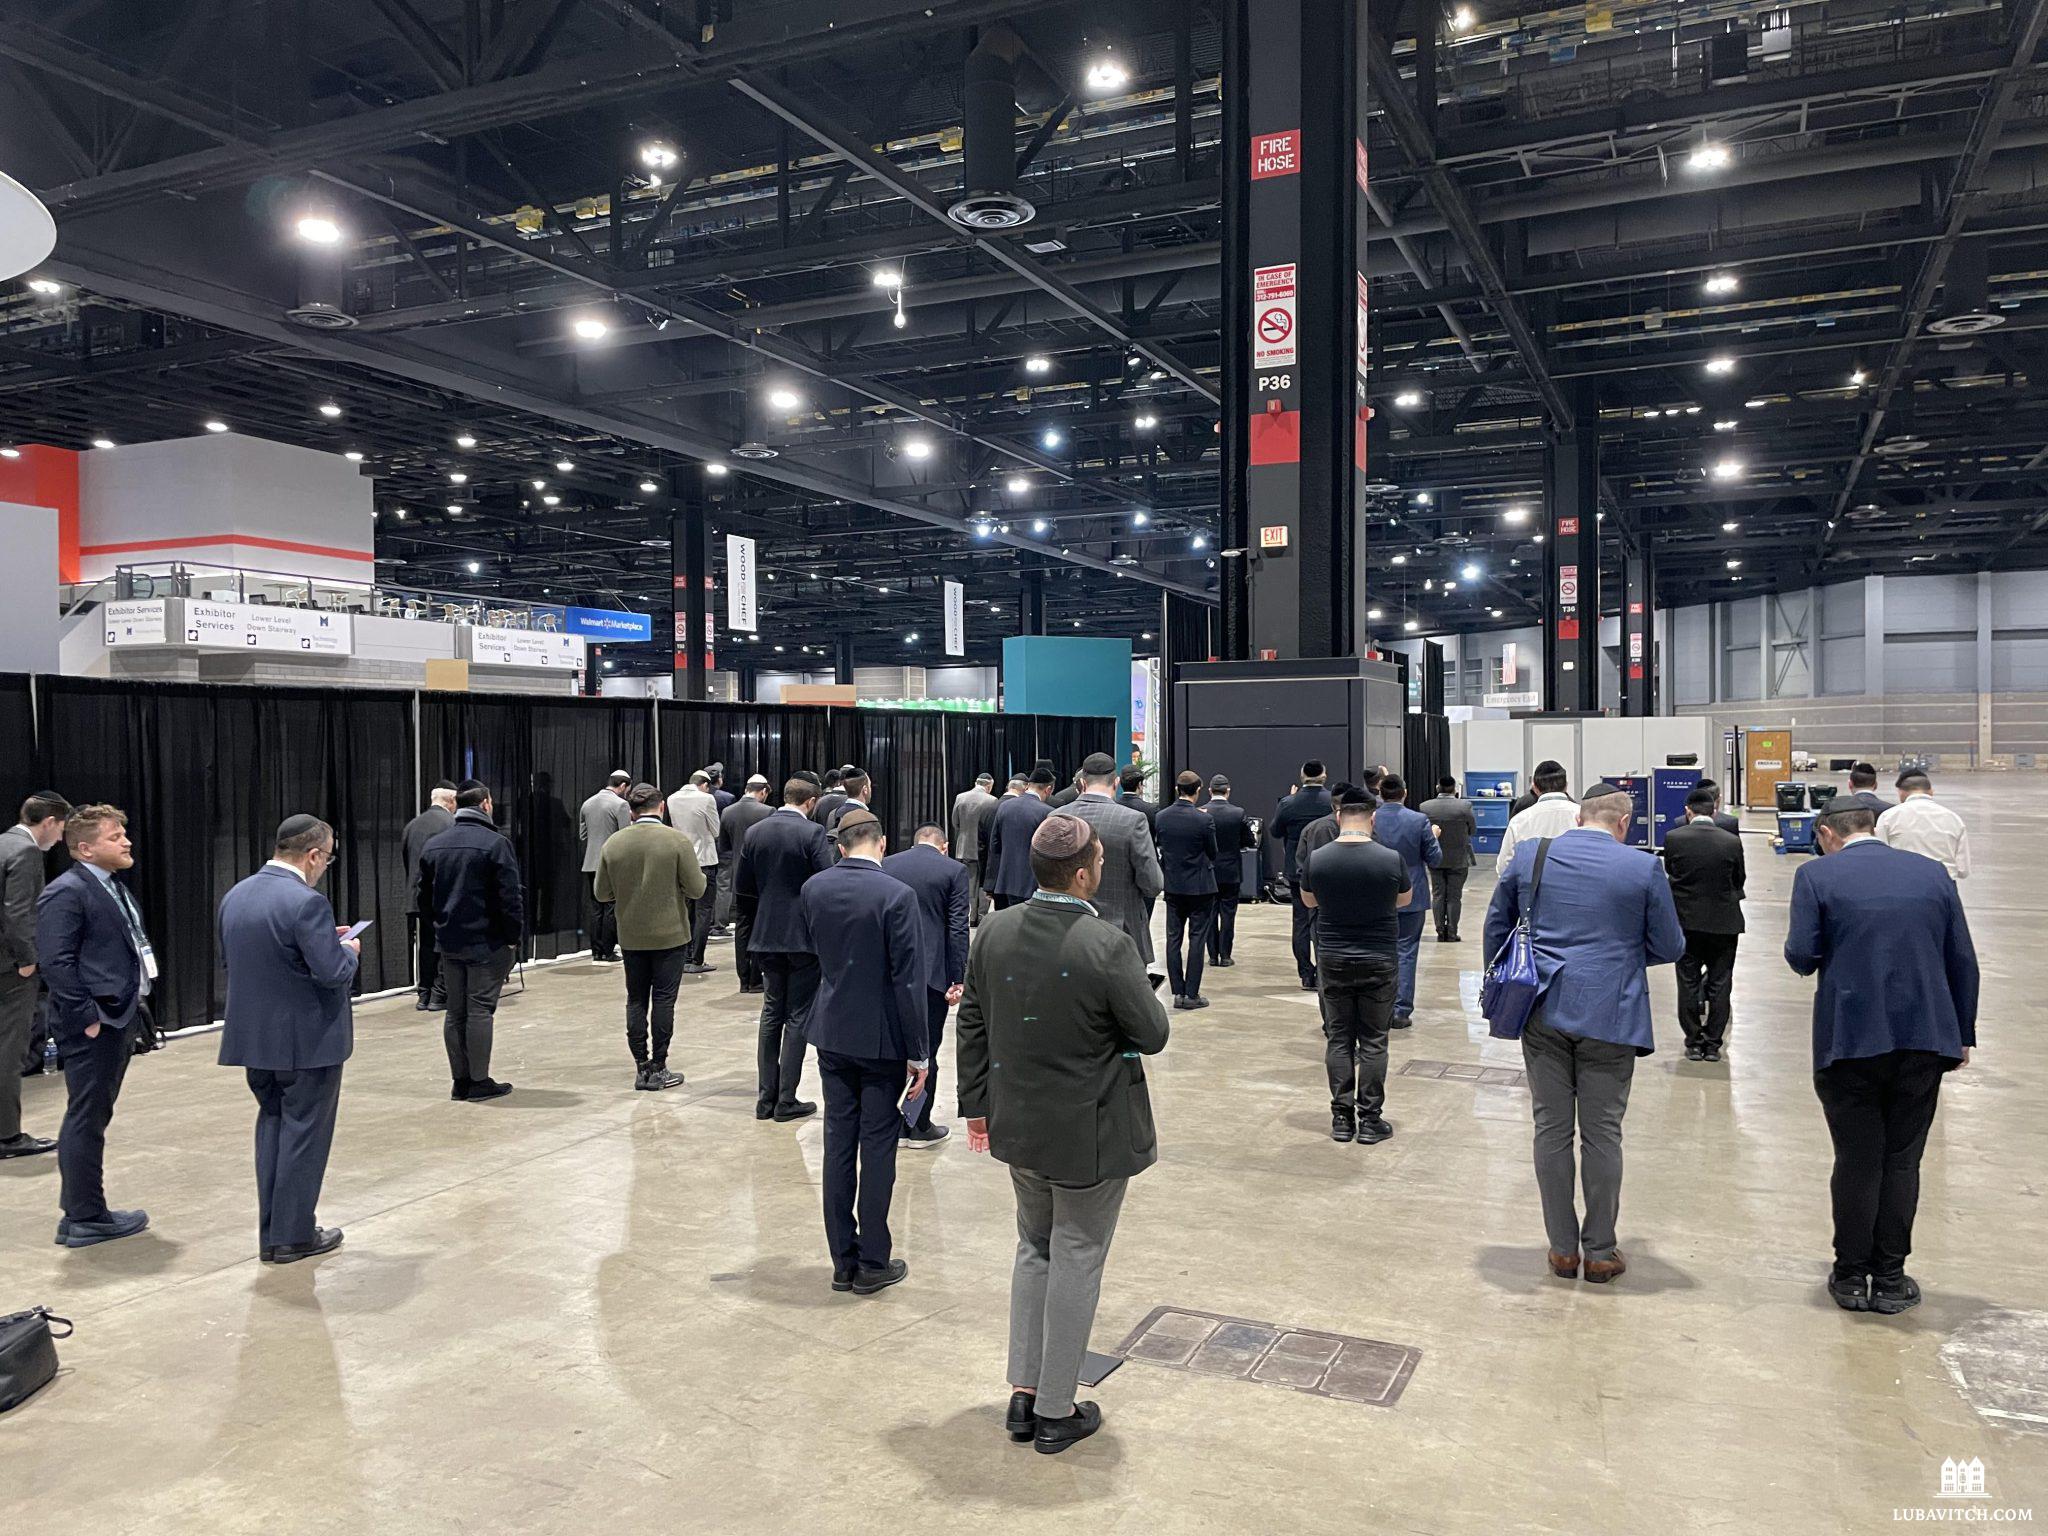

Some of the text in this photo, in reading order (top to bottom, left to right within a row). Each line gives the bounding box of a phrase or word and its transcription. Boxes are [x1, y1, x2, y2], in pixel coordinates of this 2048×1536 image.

[1260, 136, 1292, 155] FIRE
[1258, 153, 1295, 173] HOSE
[1266, 272, 1282, 281] CASE
[1284, 271, 1292, 279] OF
[1256, 277, 1294, 289] EMERGENCY
[1266, 347, 1294, 357] SMOKING
[1258, 374, 1291, 391] P36
[1264, 528, 1283, 541] EXIT
[194, 607, 236, 619] Exhibitor
[251, 614, 292, 624] Lower Level
[195, 619, 235, 631] Services
[247, 623, 297, 636] Down Stairway
[580, 617, 644, 632] Walmart Marketplace
[478, 632, 507, 641] Exhibitor
[479, 642, 506, 652] Services
